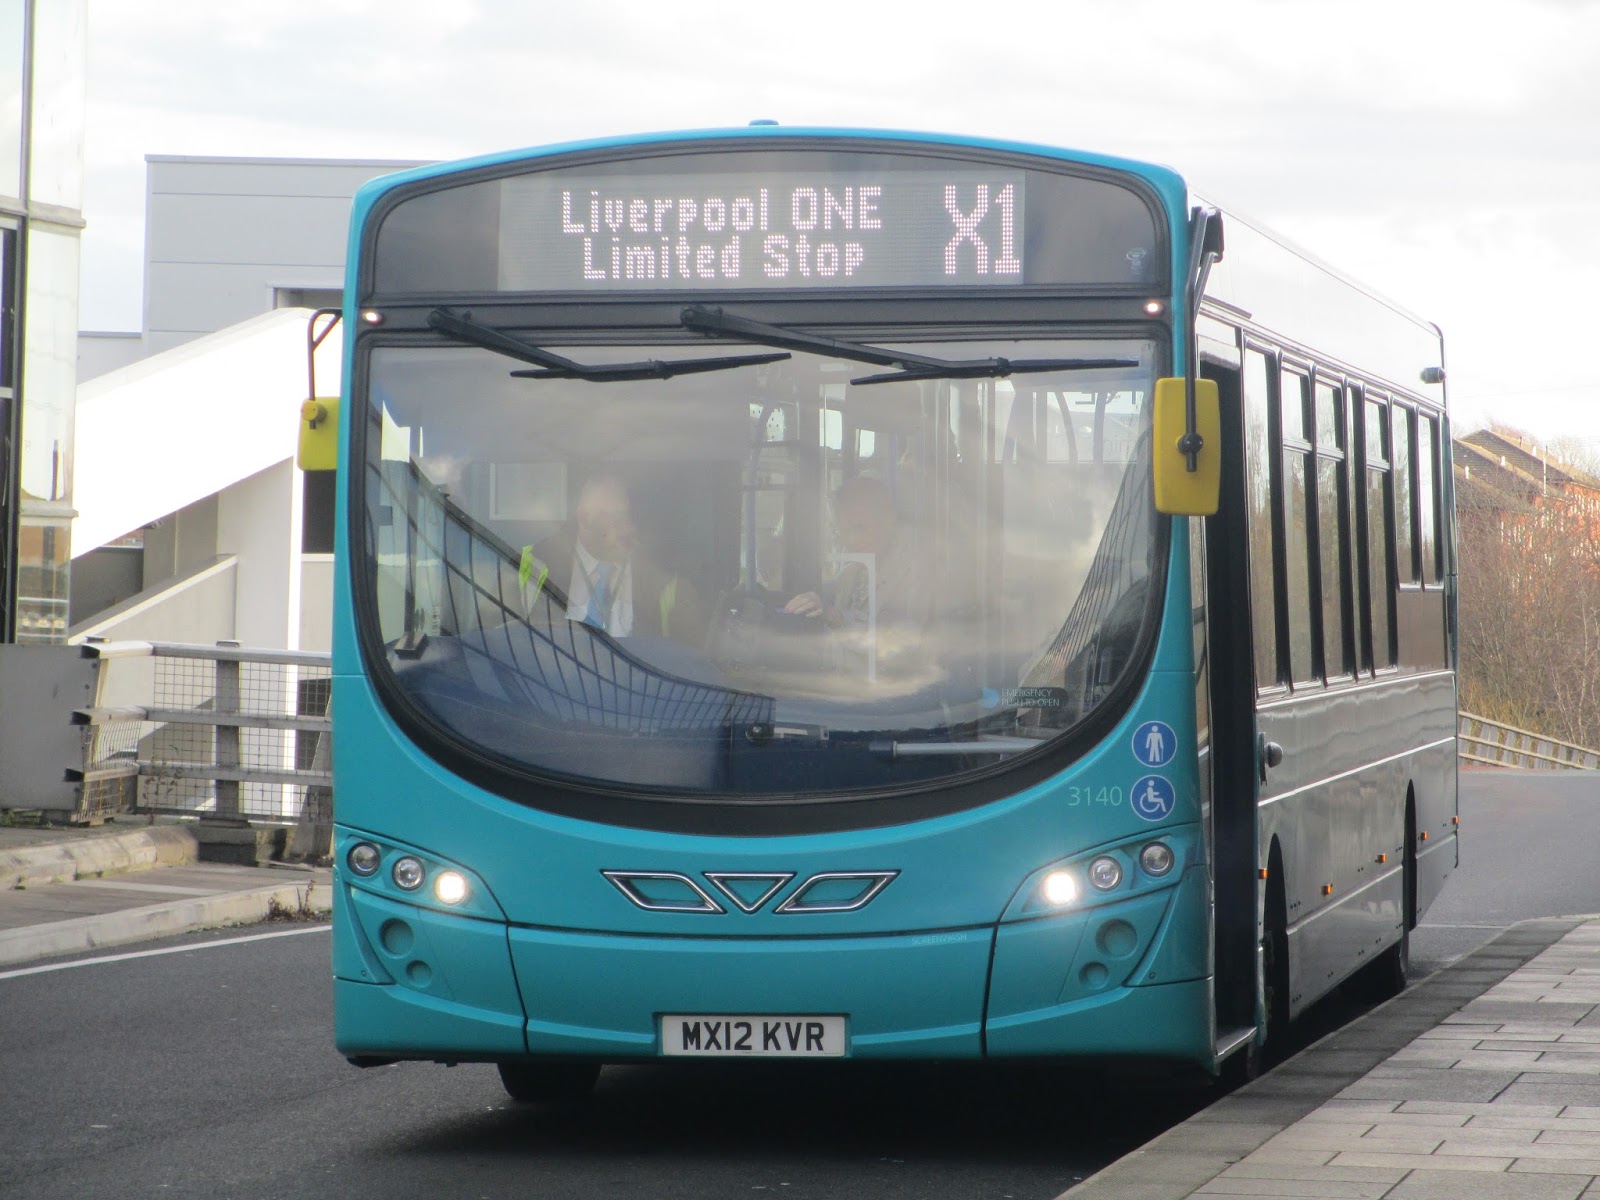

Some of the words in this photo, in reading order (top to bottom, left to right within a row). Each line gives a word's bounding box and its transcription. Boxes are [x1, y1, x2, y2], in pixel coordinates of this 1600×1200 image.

[562, 187, 768, 233] Liverpool
[791, 186, 882, 230] ONE
[944, 184, 1020, 274] X1
[583, 235, 740, 280] Limited
[763, 234, 864, 277] Stop
[1001, 687, 1053, 697] EMERGENCY
[1036, 698, 1060, 707] OPEN
[1068, 786, 1123, 806] 3140
[682, 1021, 753, 1051] MX12
[762, 1021, 824, 1051] KVR
